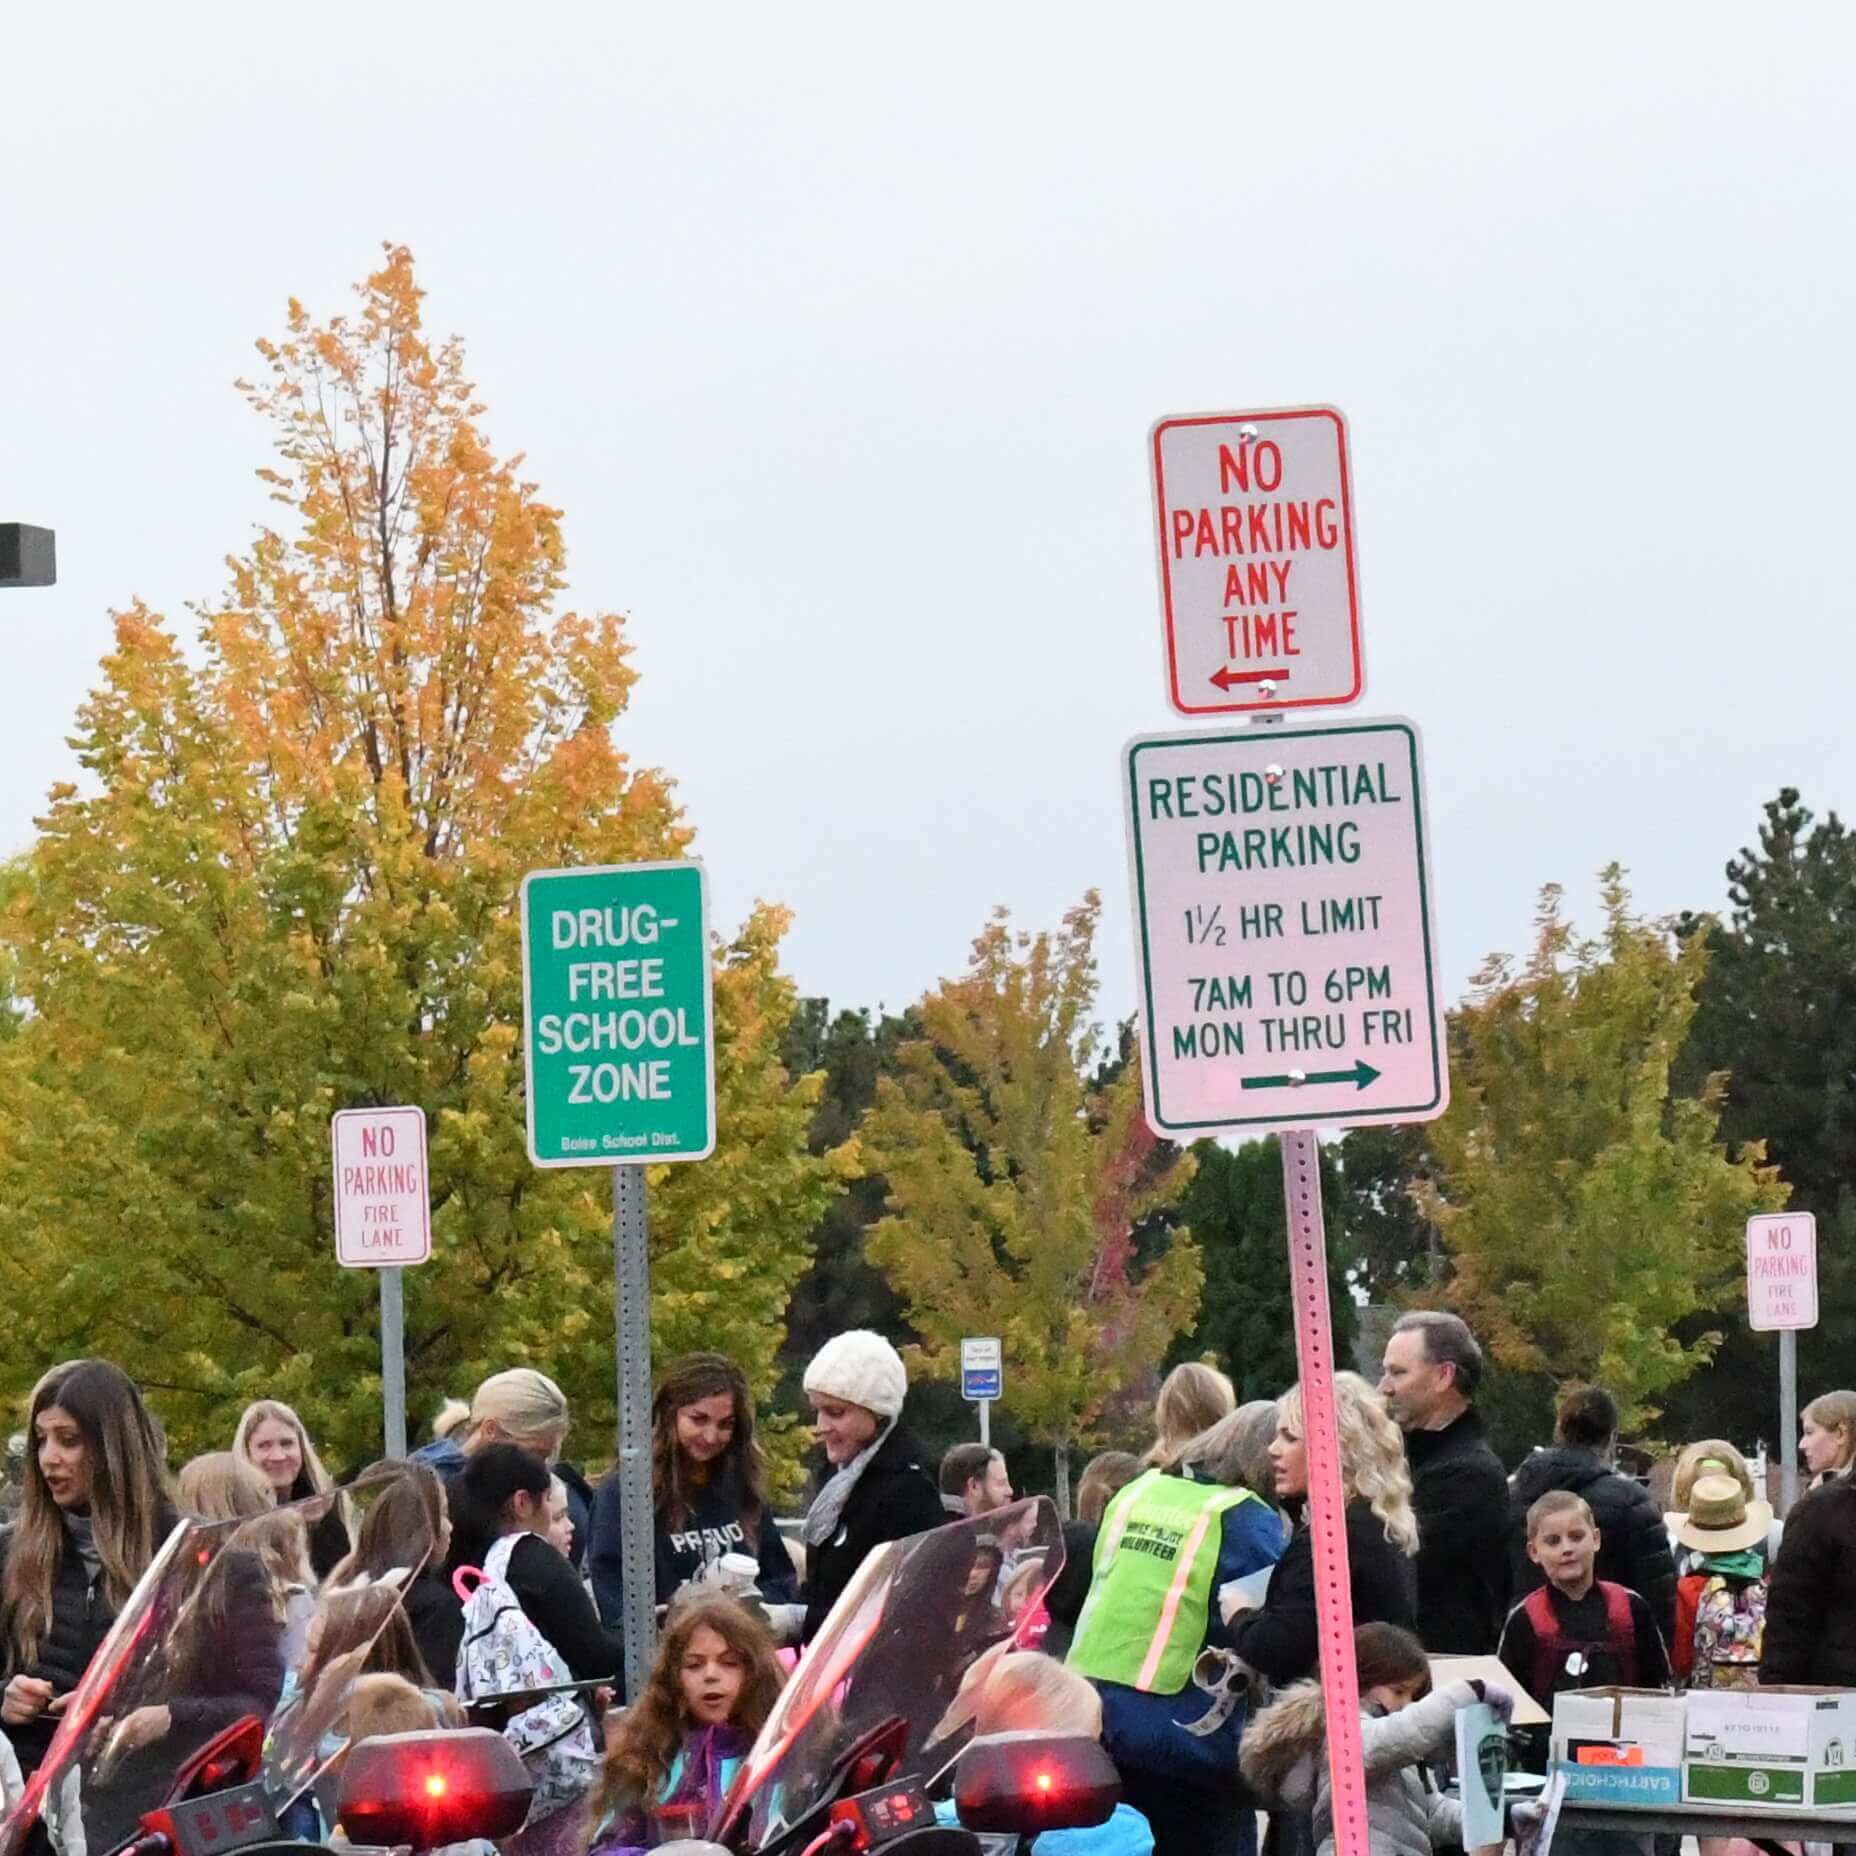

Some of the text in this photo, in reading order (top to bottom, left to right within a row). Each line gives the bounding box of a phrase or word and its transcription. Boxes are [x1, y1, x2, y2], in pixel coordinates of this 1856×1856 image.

[1219, 440, 1282, 493] NO
[1173, 498, 1337, 559] PARKING
[1224, 560, 1292, 607] ANY
[1222, 611, 1301, 659] TIME
[1149, 762, 1401, 820] RESIDENTIAL
[1197, 822, 1361, 873] PARKING
[551, 904, 679, 951] DRUG-
[1240, 904, 1284, 940] HR
[1301, 896, 1383, 936] LIMIT
[568, 958, 665, 1002] FREE
[1188, 965, 1392, 1013] 7AM TO 6PM
[538, 1007, 699, 1055] SCHOOL
[1173, 1008, 1413, 1060] MON THRU FRI
[567, 1060, 672, 1104] ZONE
[361, 1126, 395, 1158] NO
[344, 1164, 417, 1197] PARKING
[363, 1204, 400, 1224] FIRE
[361, 1228, 404, 1249] LANE
[1768, 1227, 1792, 1250] NO
[1754, 1255, 1808, 1279] PARKING
